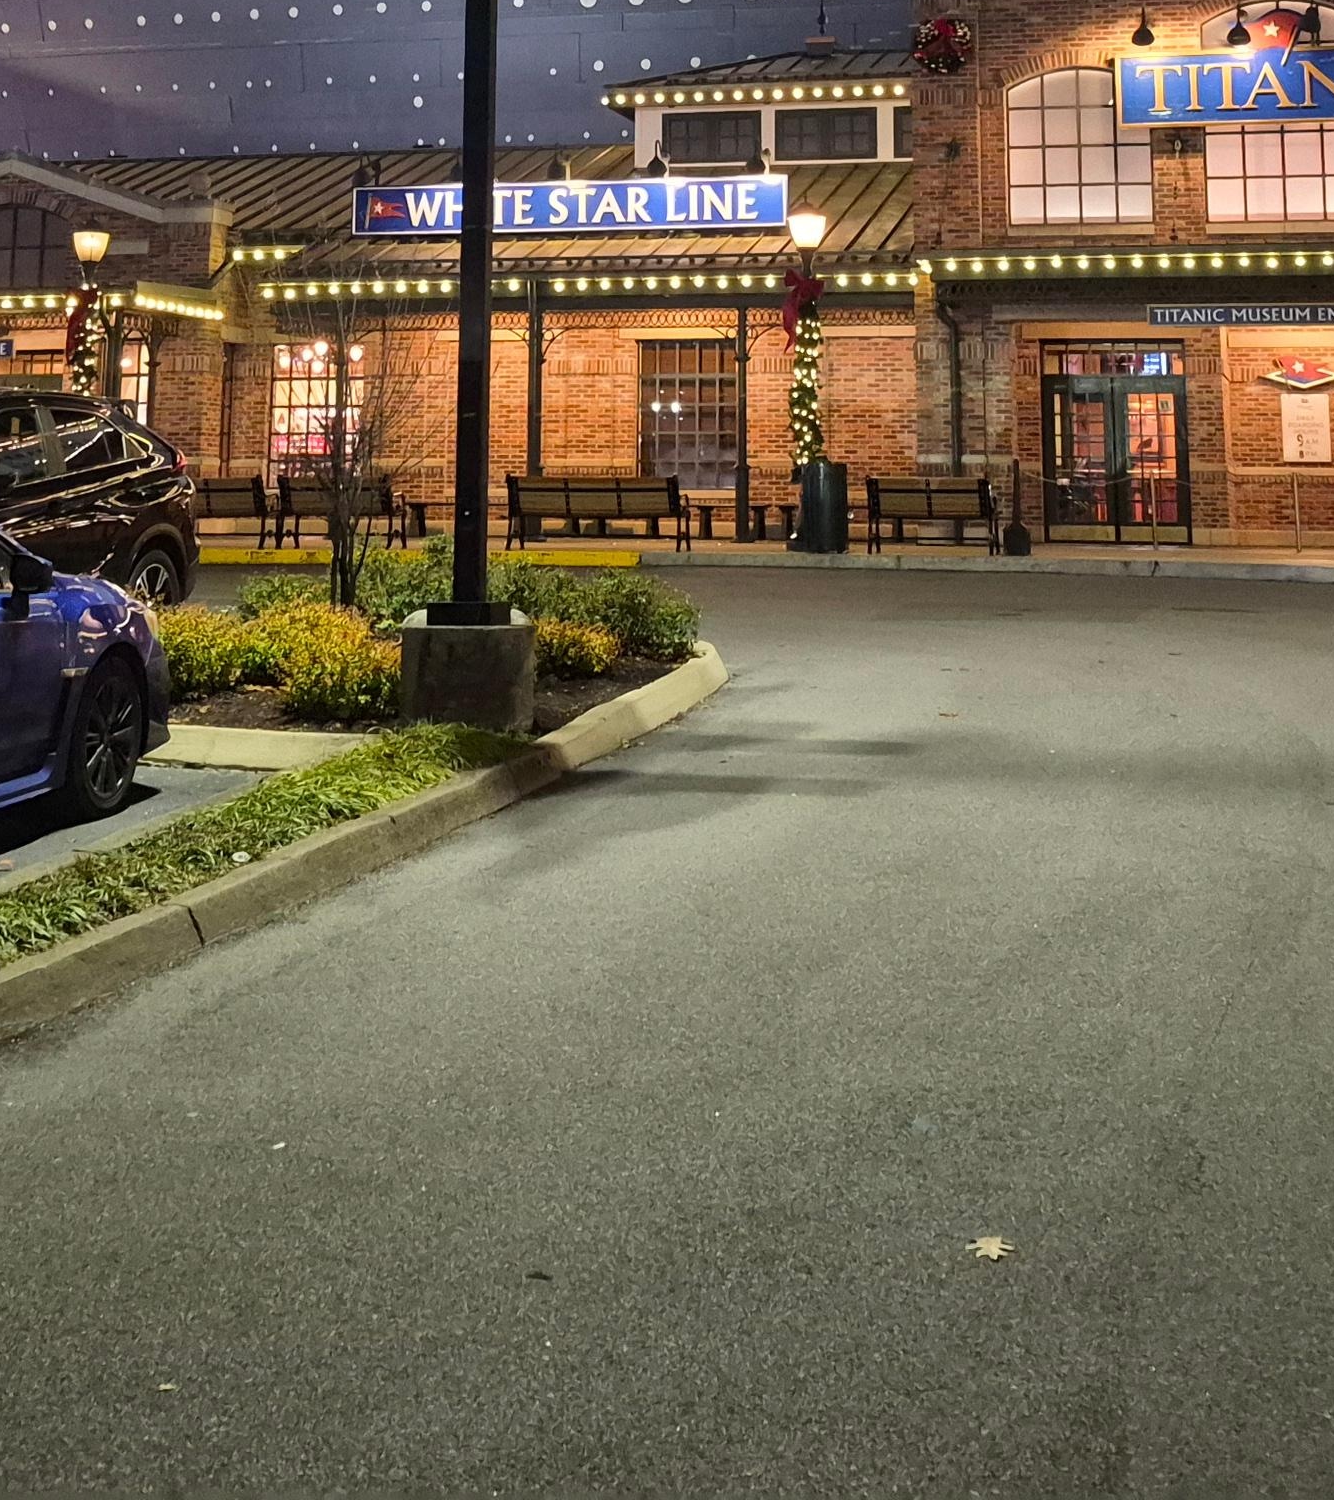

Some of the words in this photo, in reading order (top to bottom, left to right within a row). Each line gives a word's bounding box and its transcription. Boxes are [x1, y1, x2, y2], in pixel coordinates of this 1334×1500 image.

[404, 188, 534, 228] WHTE
[548, 186, 651, 225] STAR
[666, 183, 759, 223] LINE
[1153, 308, 1225, 323] TITANIC
[1232, 307, 1311, 322] MUSEUM
